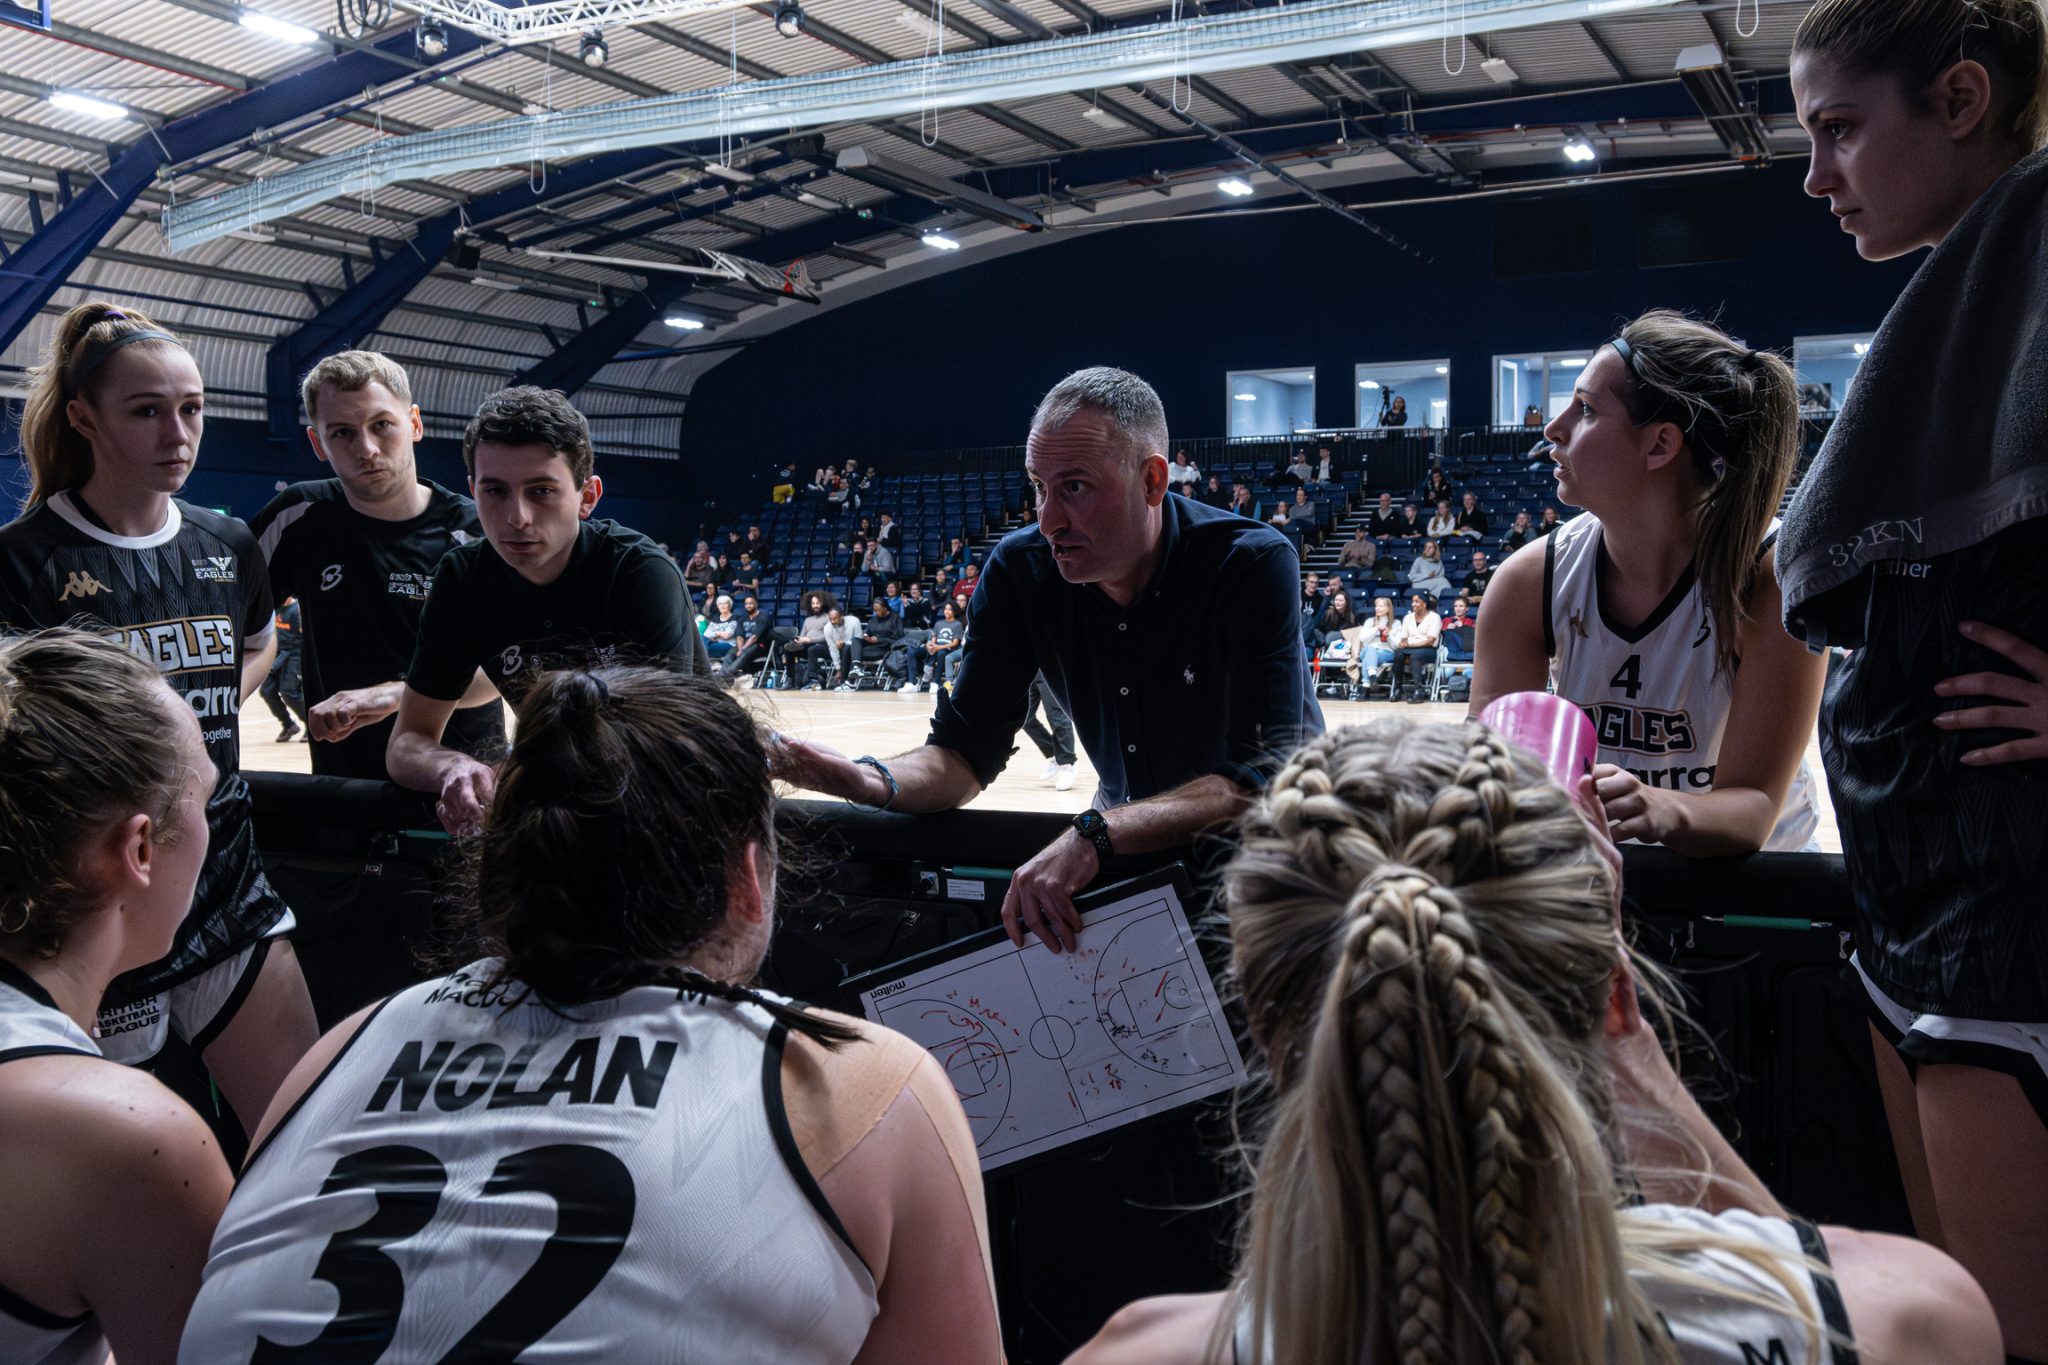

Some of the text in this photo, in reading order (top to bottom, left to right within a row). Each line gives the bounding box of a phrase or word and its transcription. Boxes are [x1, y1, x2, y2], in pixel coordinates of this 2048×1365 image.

[1610, 654, 1642, 699] 4
[202, 726, 232, 744] ogether
[870, 980, 906, 999] molten
[98, 1005, 160, 1029] ASKETBALL
[100, 1014, 161, 1039] EAGUE
[365, 1035, 679, 1113] NOLAN
[249, 1144, 637, 1365] 32
